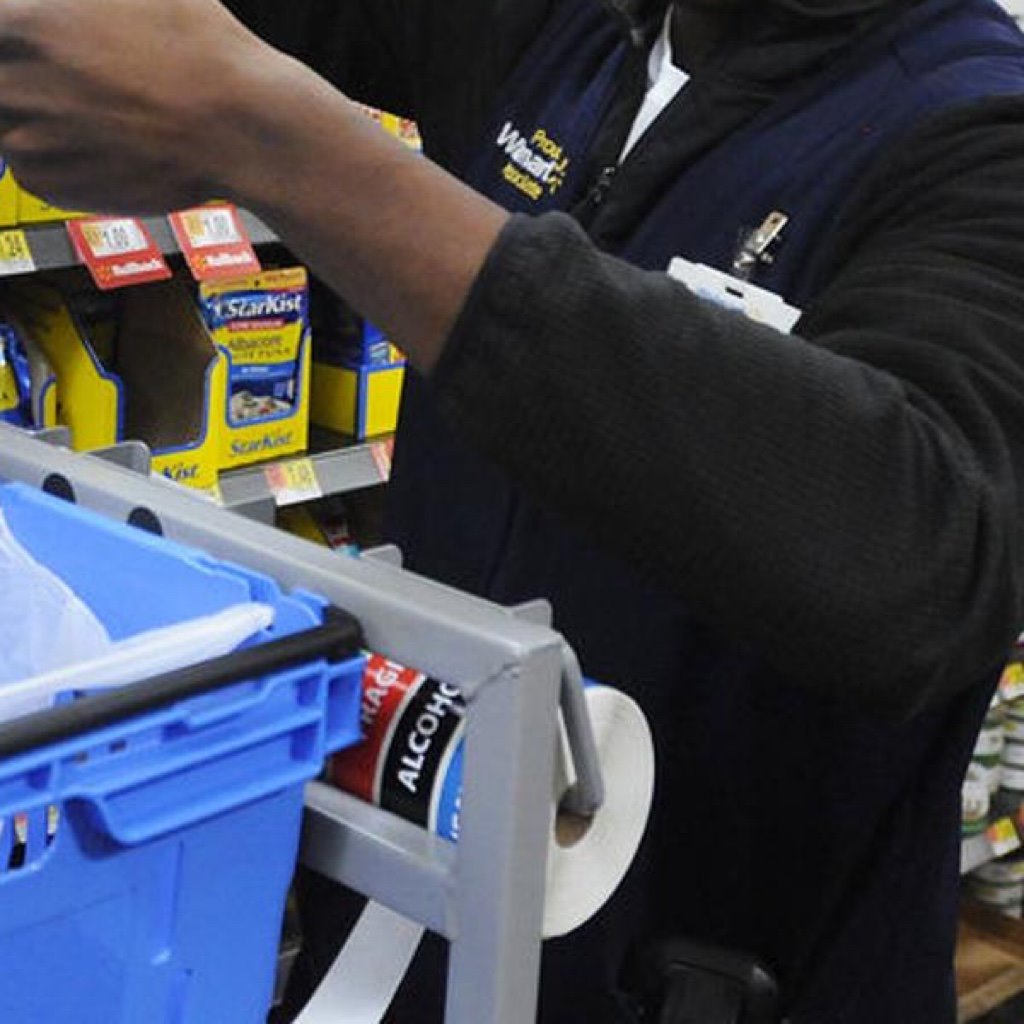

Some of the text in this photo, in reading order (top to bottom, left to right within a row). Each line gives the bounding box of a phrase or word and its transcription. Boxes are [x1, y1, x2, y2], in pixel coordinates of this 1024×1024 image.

[111, 257, 163, 276] Rollback
[227, 291, 303, 319] StarKist
[231, 431, 293, 457] StarKist
[162, 462, 198, 479] Kist
[397, 682, 462, 794] ALCOHO
